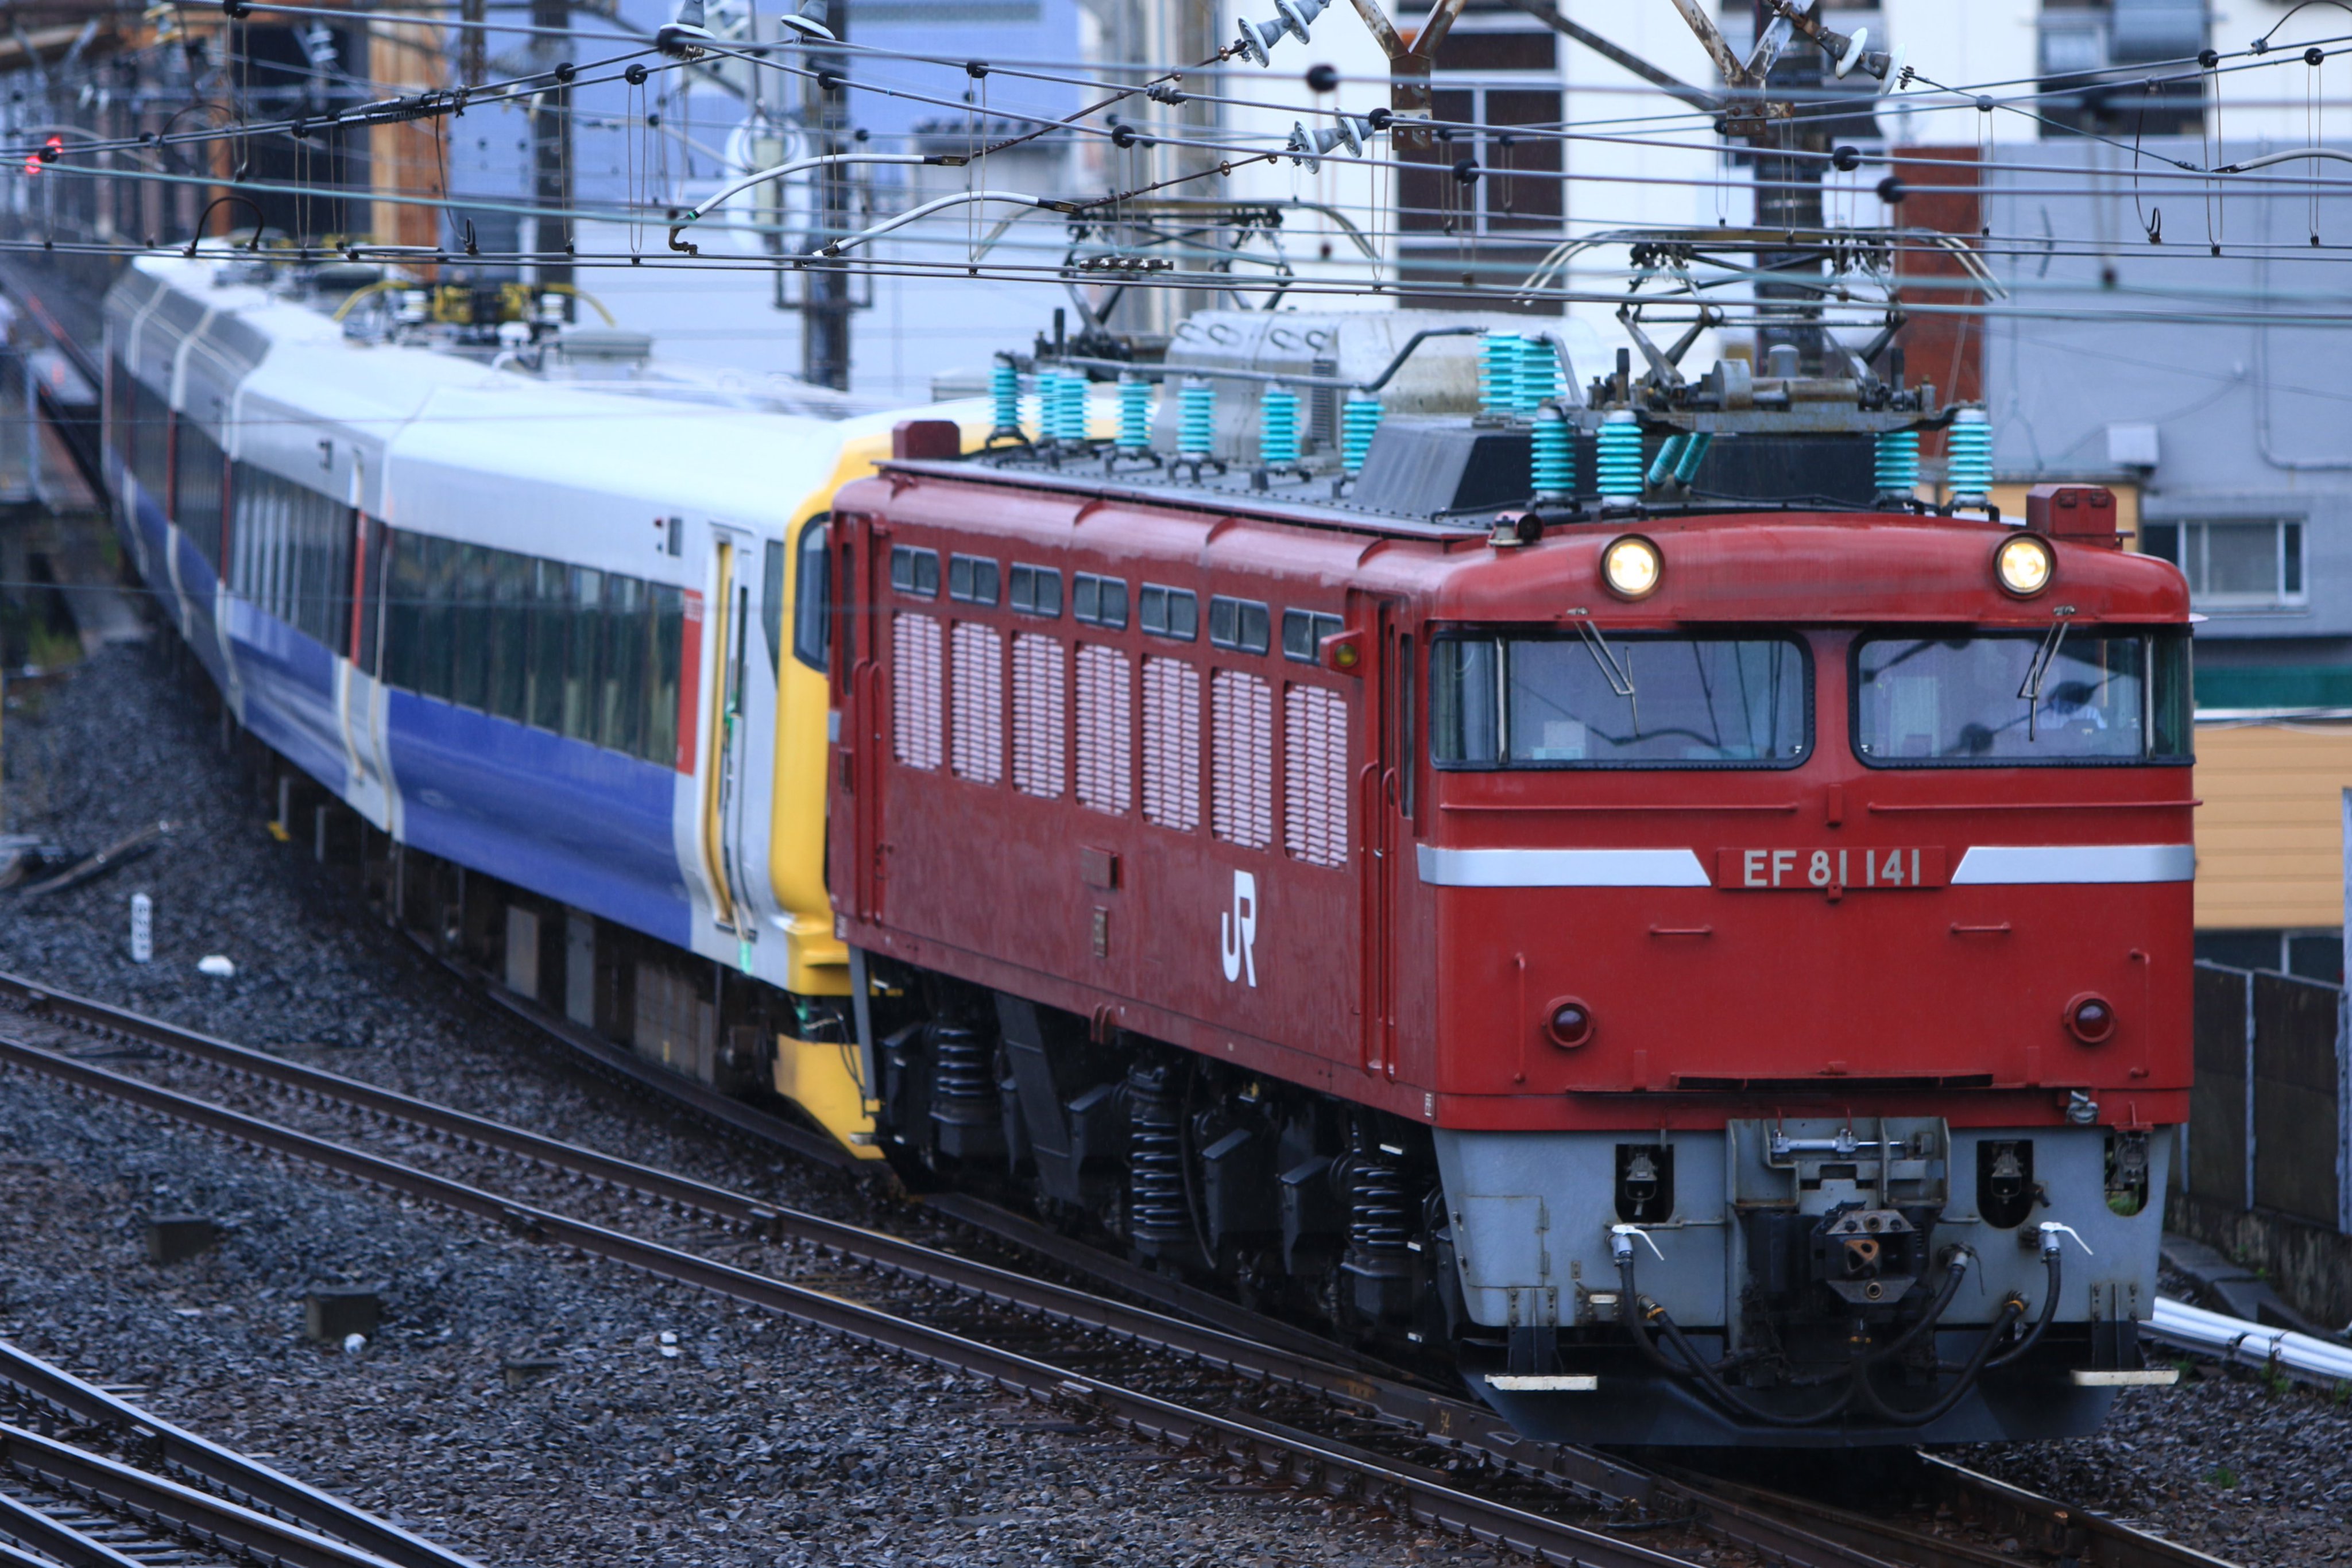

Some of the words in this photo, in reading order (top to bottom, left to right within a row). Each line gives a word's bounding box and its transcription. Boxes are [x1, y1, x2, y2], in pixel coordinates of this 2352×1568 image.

[1744, 850, 1797, 886] EF
[1866, 849, 1920, 886] 141
[1221, 869, 1257, 988] JR
